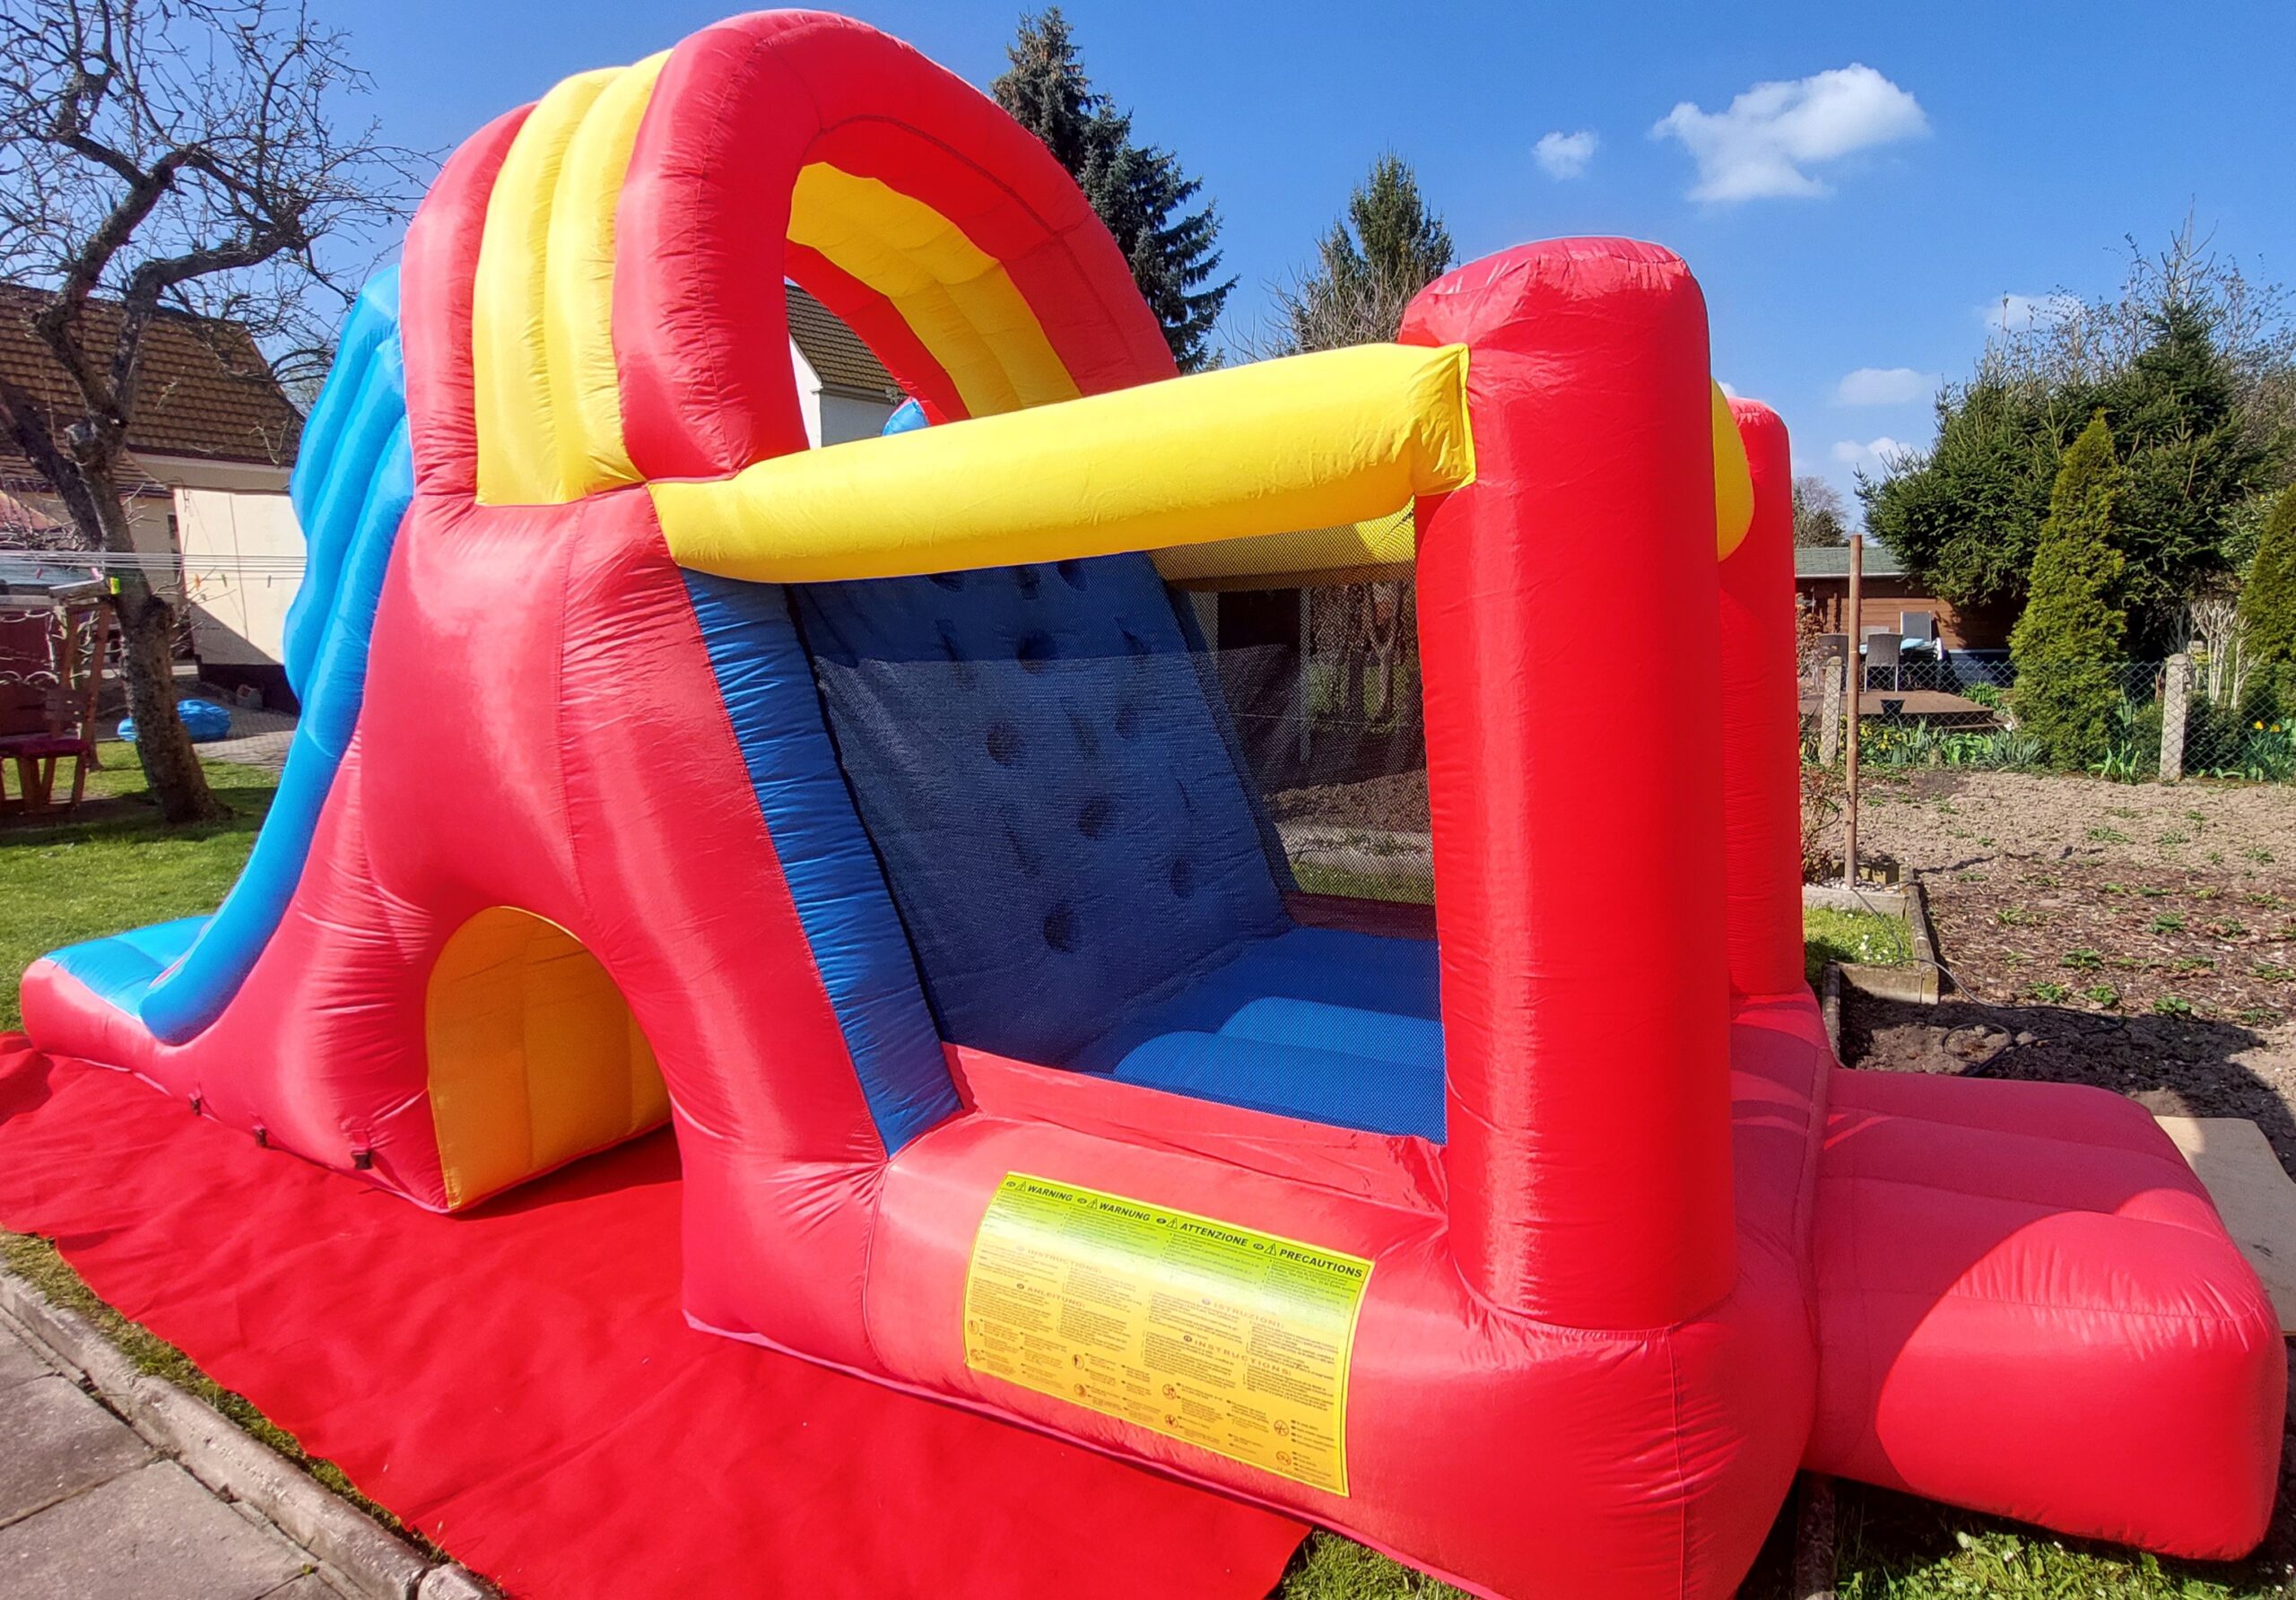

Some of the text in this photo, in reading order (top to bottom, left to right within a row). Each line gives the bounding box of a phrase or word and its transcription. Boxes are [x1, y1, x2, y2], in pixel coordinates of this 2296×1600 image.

[1028, 1185, 1074, 1202] WARNING
[1100, 1202, 1151, 1222] WARNUNG
[1180, 1222, 1248, 1247] ATTENZIONE
[1279, 1248, 1362, 1278] PRECAUTIONS
